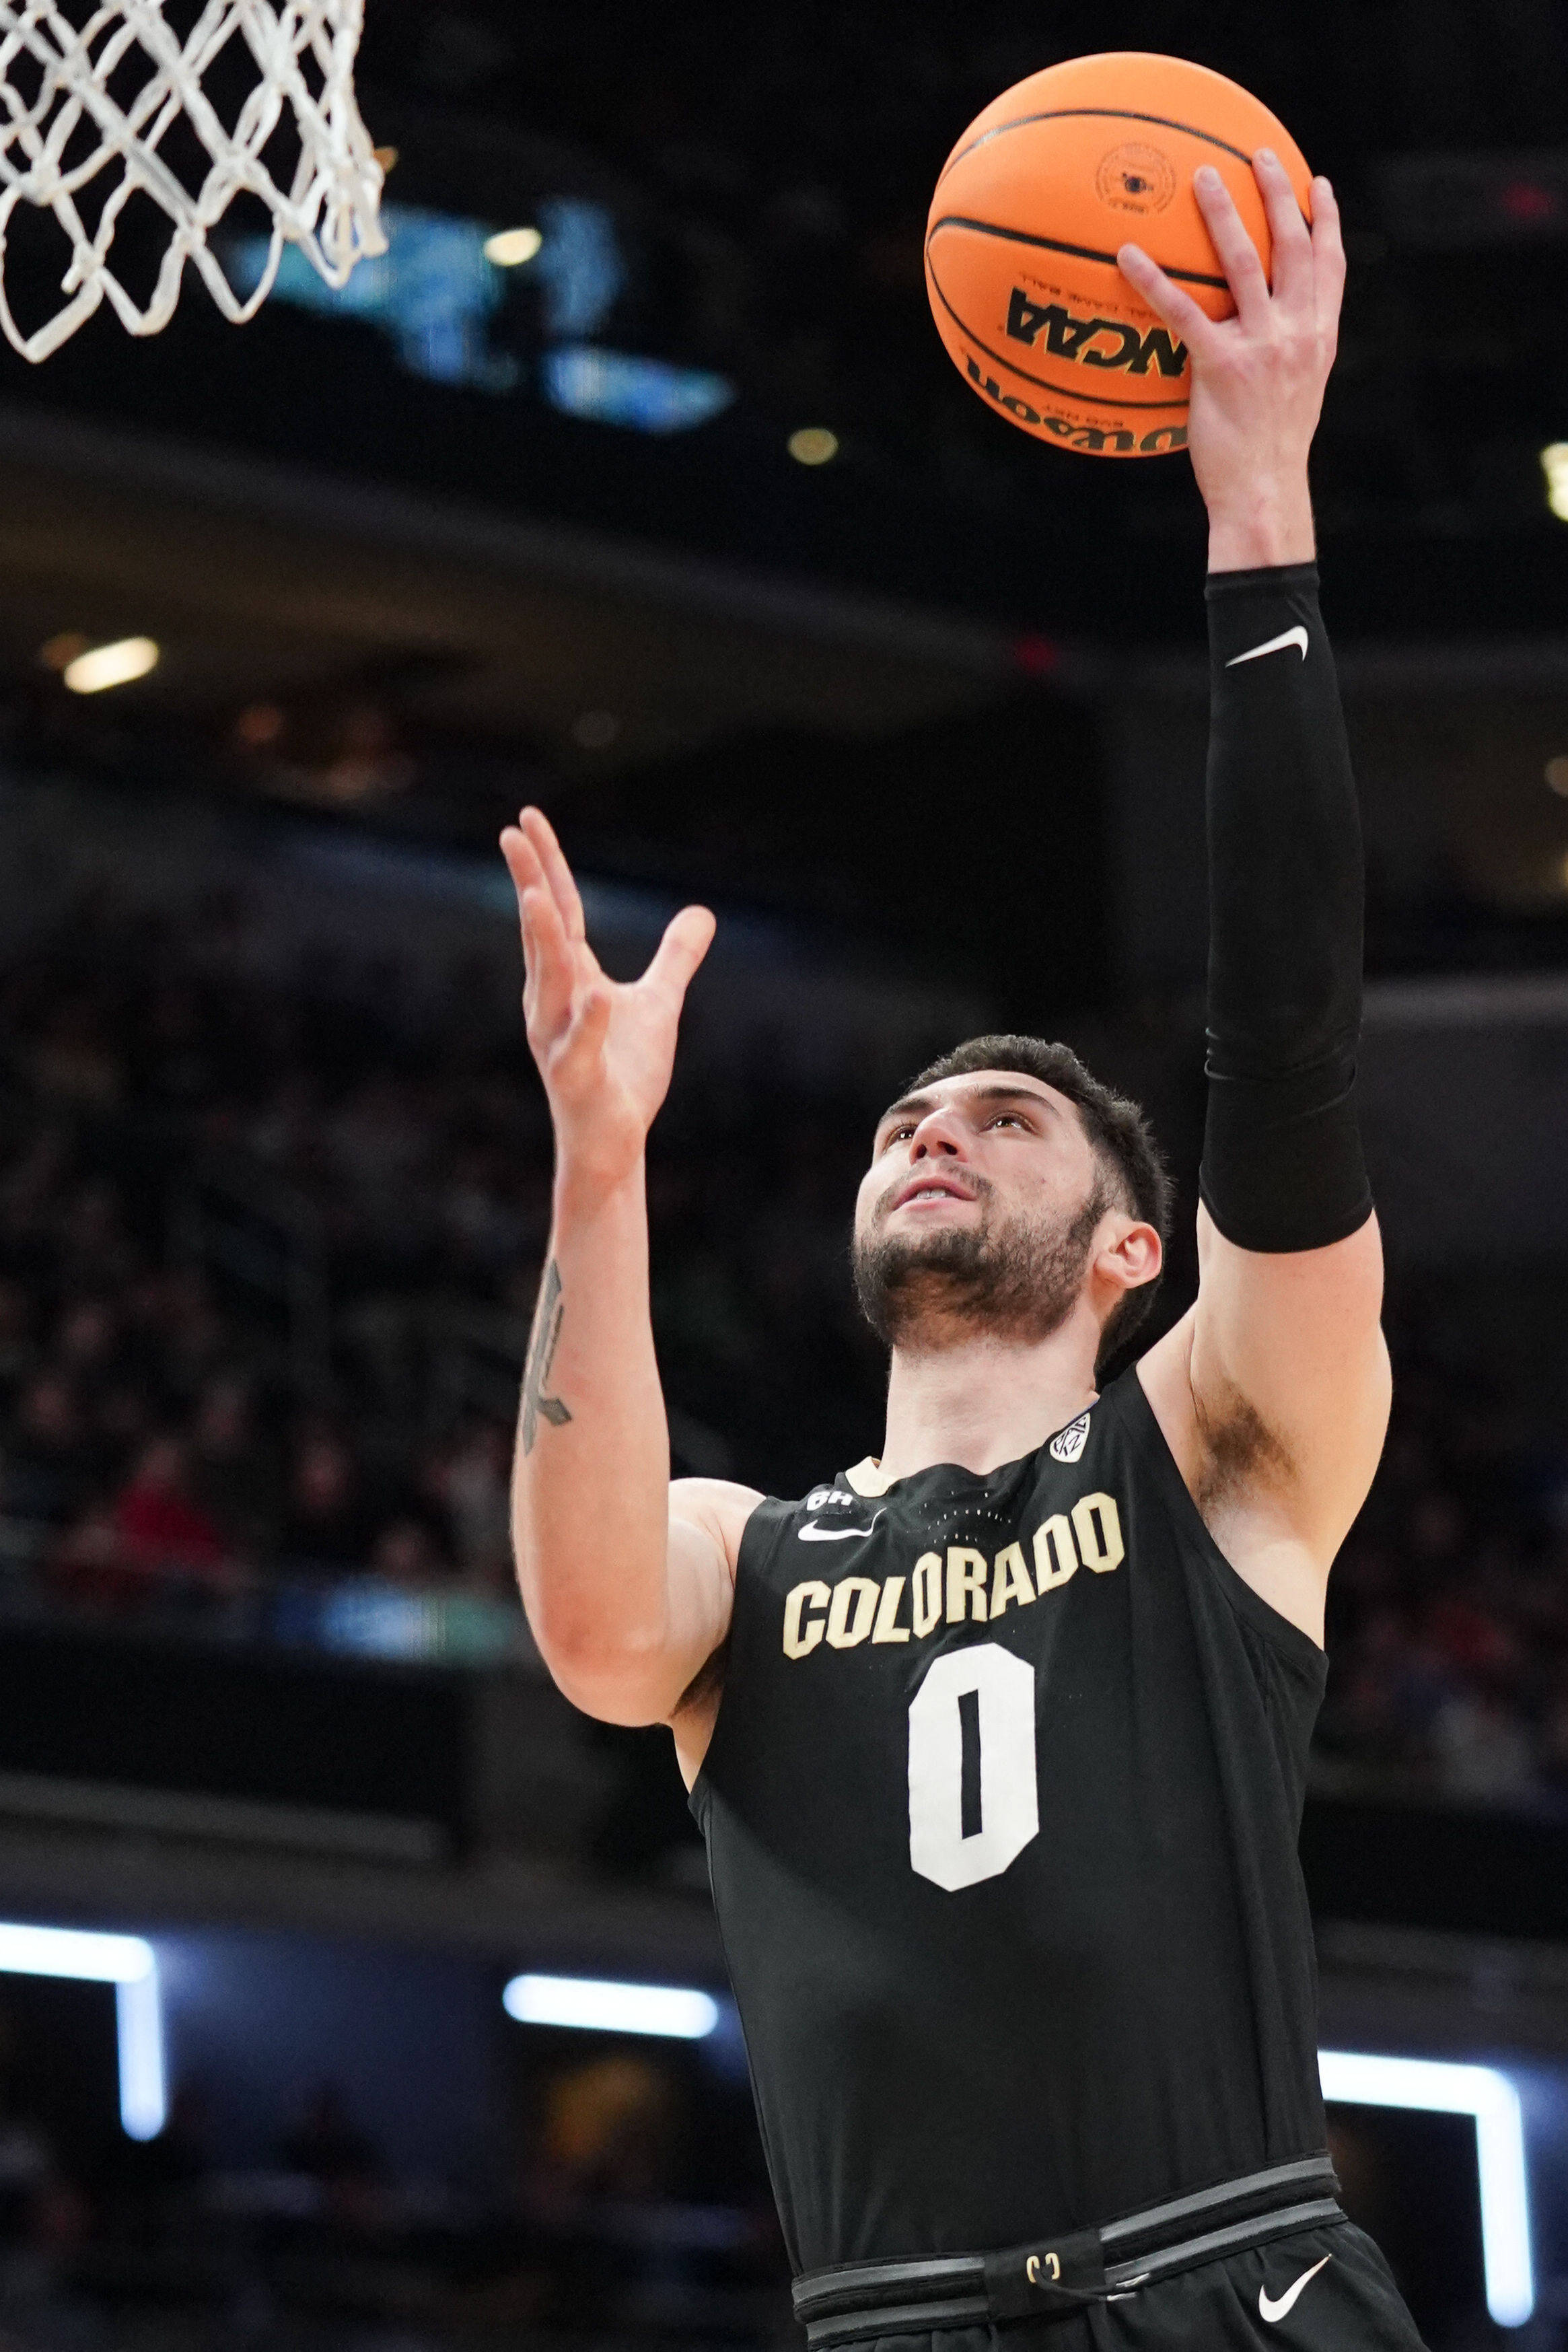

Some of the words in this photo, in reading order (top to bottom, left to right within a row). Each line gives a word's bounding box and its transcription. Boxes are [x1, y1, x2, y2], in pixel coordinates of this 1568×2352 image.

[1006, 286, 1190, 378] NCAA
[783, 1491, 1125, 1660] COLORADO
[908, 1643, 1039, 1892] 0
